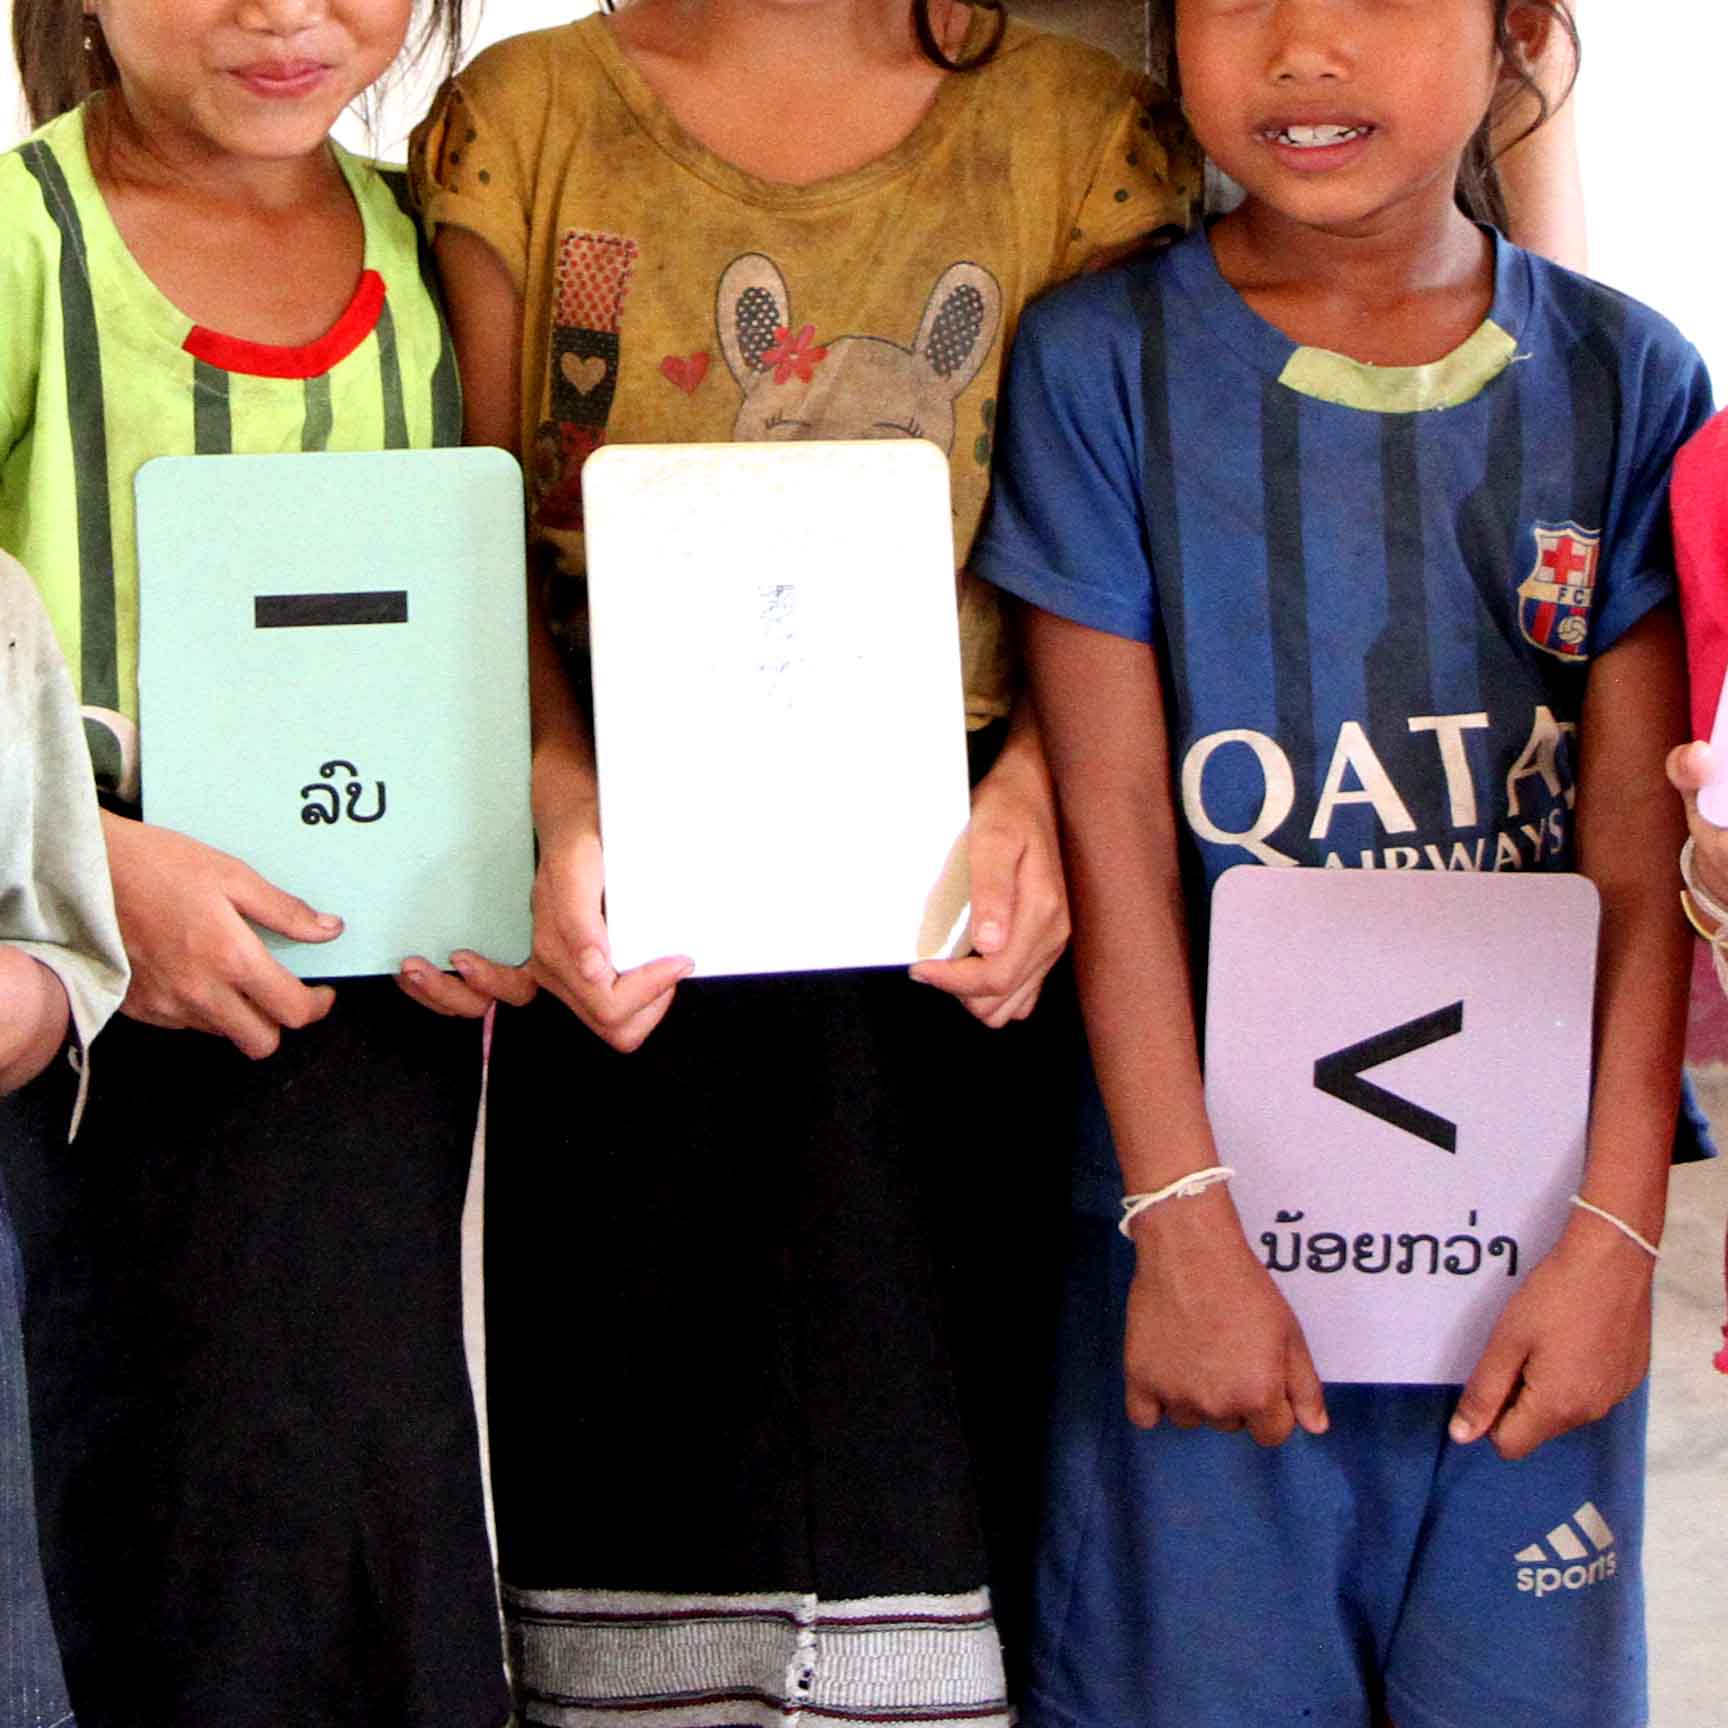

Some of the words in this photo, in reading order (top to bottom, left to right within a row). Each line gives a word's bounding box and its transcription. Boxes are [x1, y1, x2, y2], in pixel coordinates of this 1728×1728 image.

[300, 760, 387, 826] ລົບ
[1182, 705, 1575, 868] QATA
[1259, 1209, 1520, 1278] ນ້ອຍກວ່າ
[1515, 1550, 1617, 1598] sports
